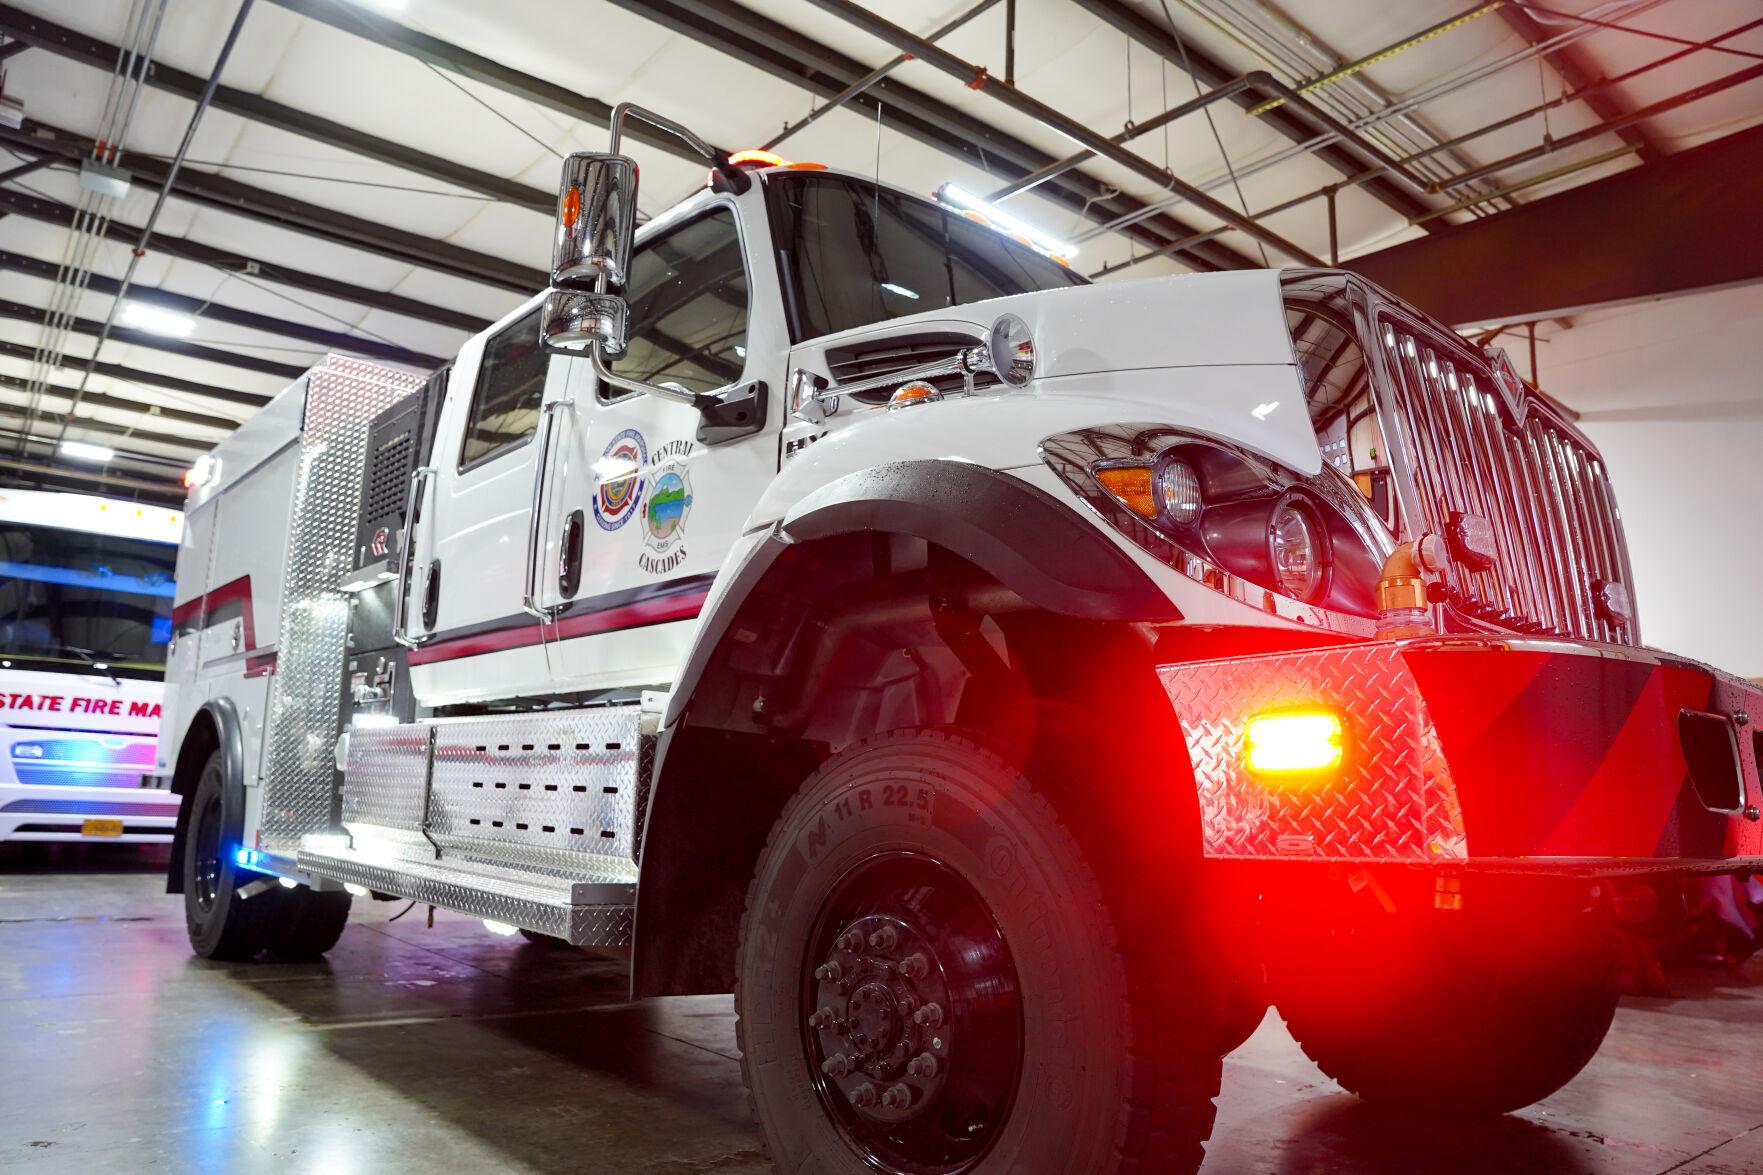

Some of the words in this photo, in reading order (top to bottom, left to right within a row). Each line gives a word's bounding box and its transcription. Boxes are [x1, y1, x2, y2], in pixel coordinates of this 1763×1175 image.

[651, 440, 694, 466] CENTRAL
[663, 464, 676, 473] FIRE
[638, 545, 687, 574] CASCADES
[69, 697, 122, 716] FIRE
[834, 797, 853, 821] 11
[858, 789, 873, 811] R
[882, 785, 929, 810] 22.5
